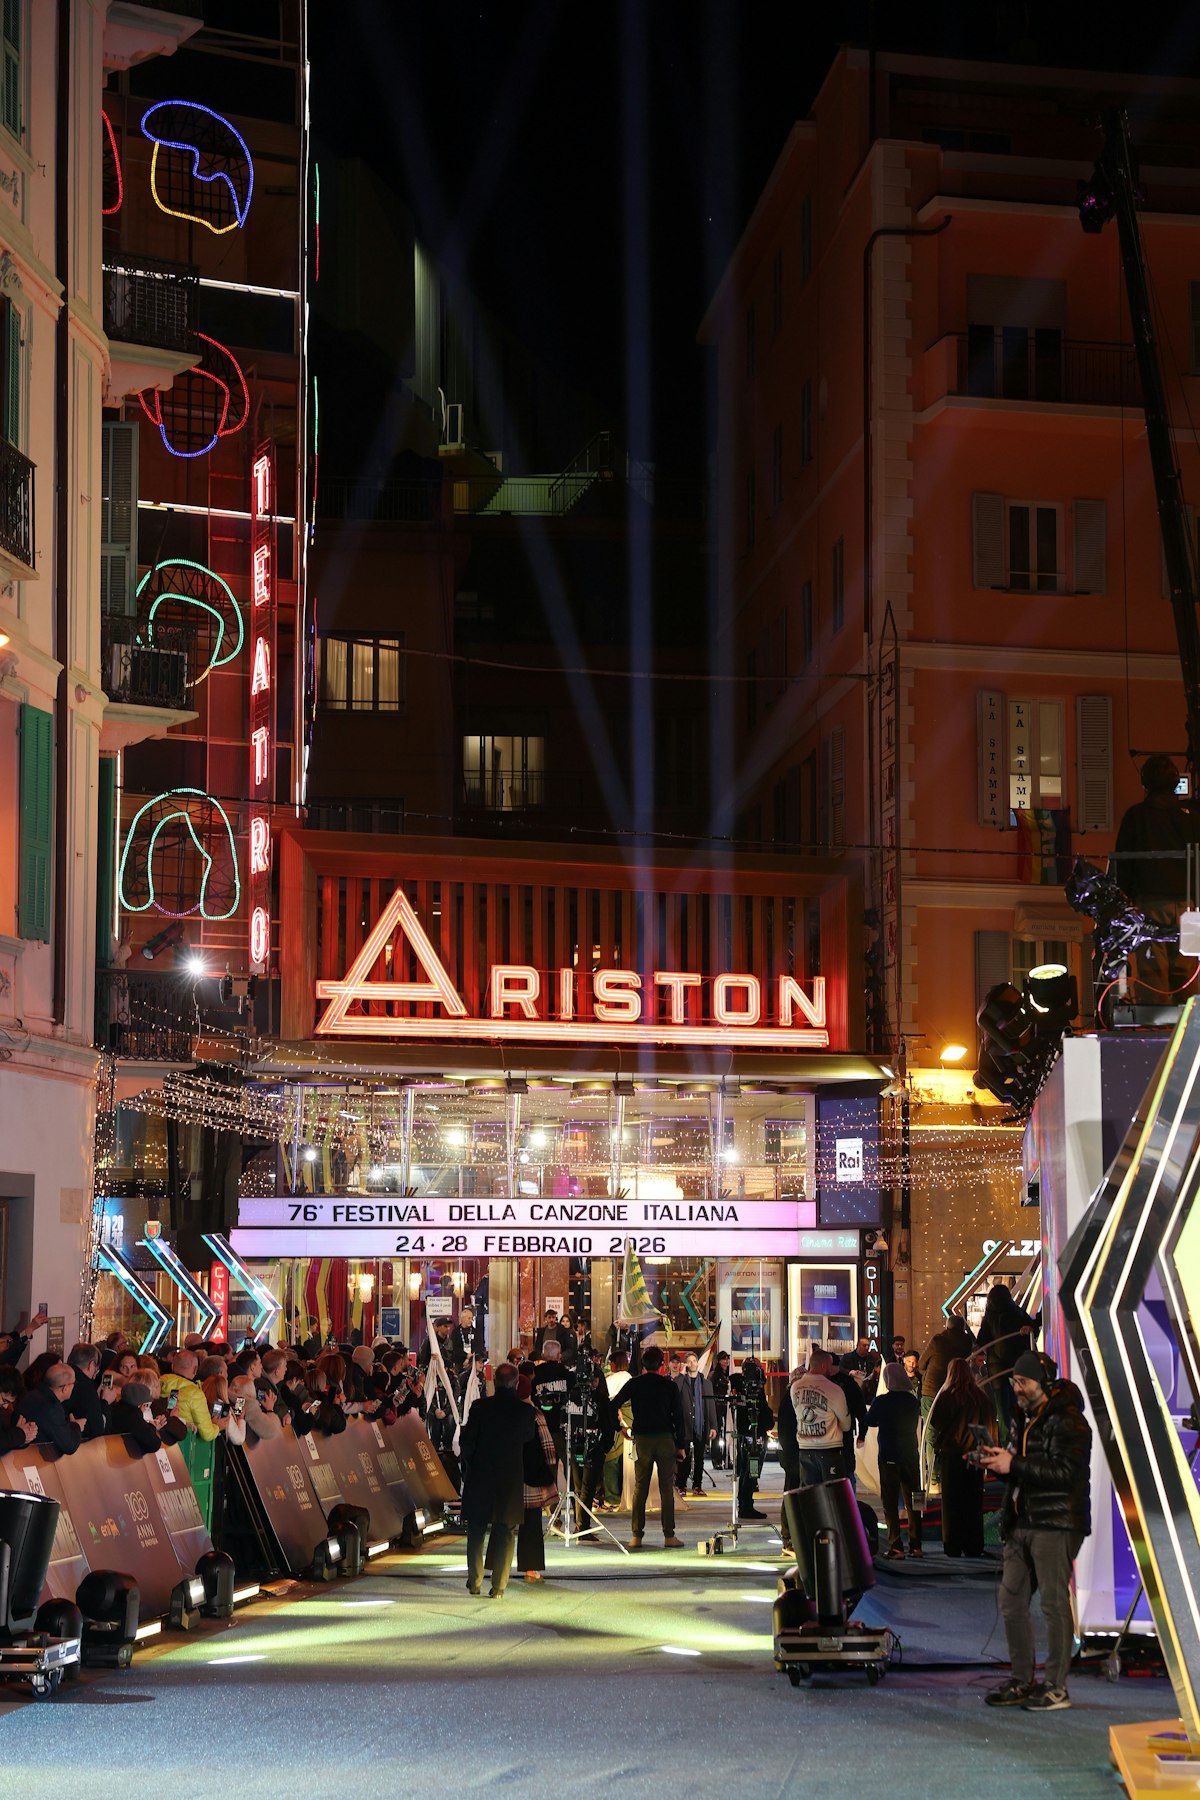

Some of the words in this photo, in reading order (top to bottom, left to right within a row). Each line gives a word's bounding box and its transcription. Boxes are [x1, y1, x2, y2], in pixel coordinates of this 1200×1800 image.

[251, 455, 270, 964] TEATRO
[988, 697, 996, 721] LA
[1015, 705, 1024, 728] LA
[989, 738, 998, 817] STAMPA
[1016, 745, 1027, 809] STAMP
[315, 888, 828, 1046] ARISTON
[839, 1150, 860, 1169] Rai
[333, 1205, 435, 1222] FESTIVAL
[449, 1204, 517, 1221] DELLA
[530, 1204, 628, 1221] CANZONE
[643, 1204, 739, 1222] ITALIANA
[484, 1235, 593, 1253] FEBBRAIO
[609, 1237, 666, 1253] 2026
[801, 1236, 833, 1248] Cinema
[982, 1239, 1042, 1257] CLZ
[866, 1266, 879, 1353] CINEMA
[124, 1490, 149, 1522] 100
[136, 1523, 156, 1540] ANNI
